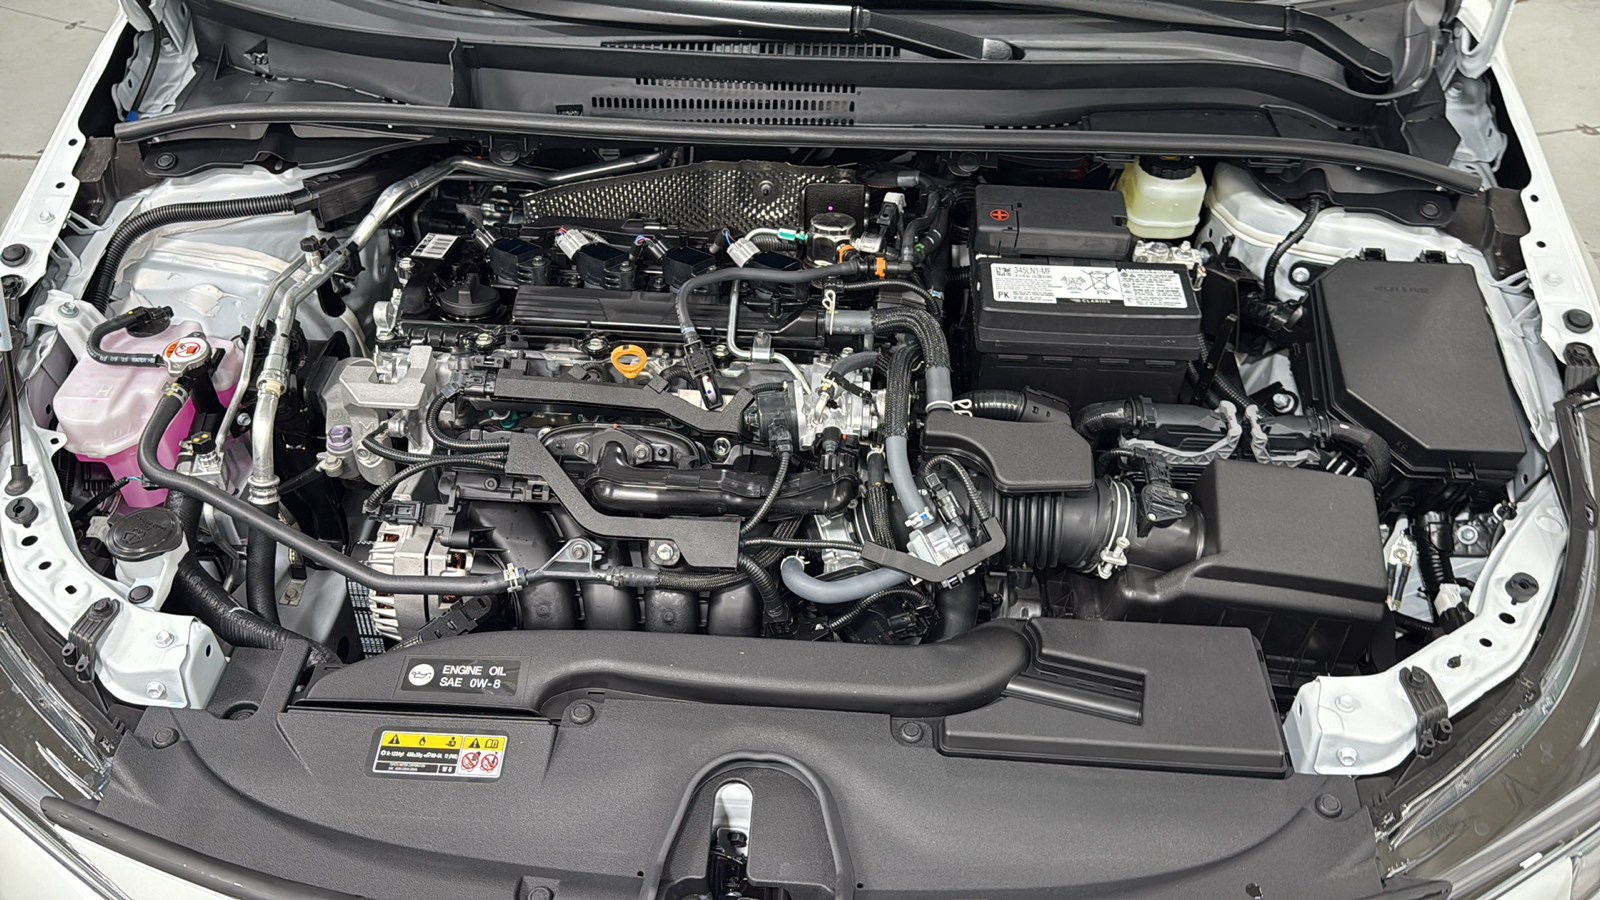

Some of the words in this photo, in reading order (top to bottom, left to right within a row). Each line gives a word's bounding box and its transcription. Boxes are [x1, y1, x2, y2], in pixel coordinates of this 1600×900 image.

[1014, 266, 1051, 275] 345LN1-MF
[998, 291, 1009, 299] PK
[442, 665, 483, 676] ENGINE
[488, 666, 507, 676] OIL
[439, 677, 463, 687] SAE
[469, 679, 501, 688] 0W-8
